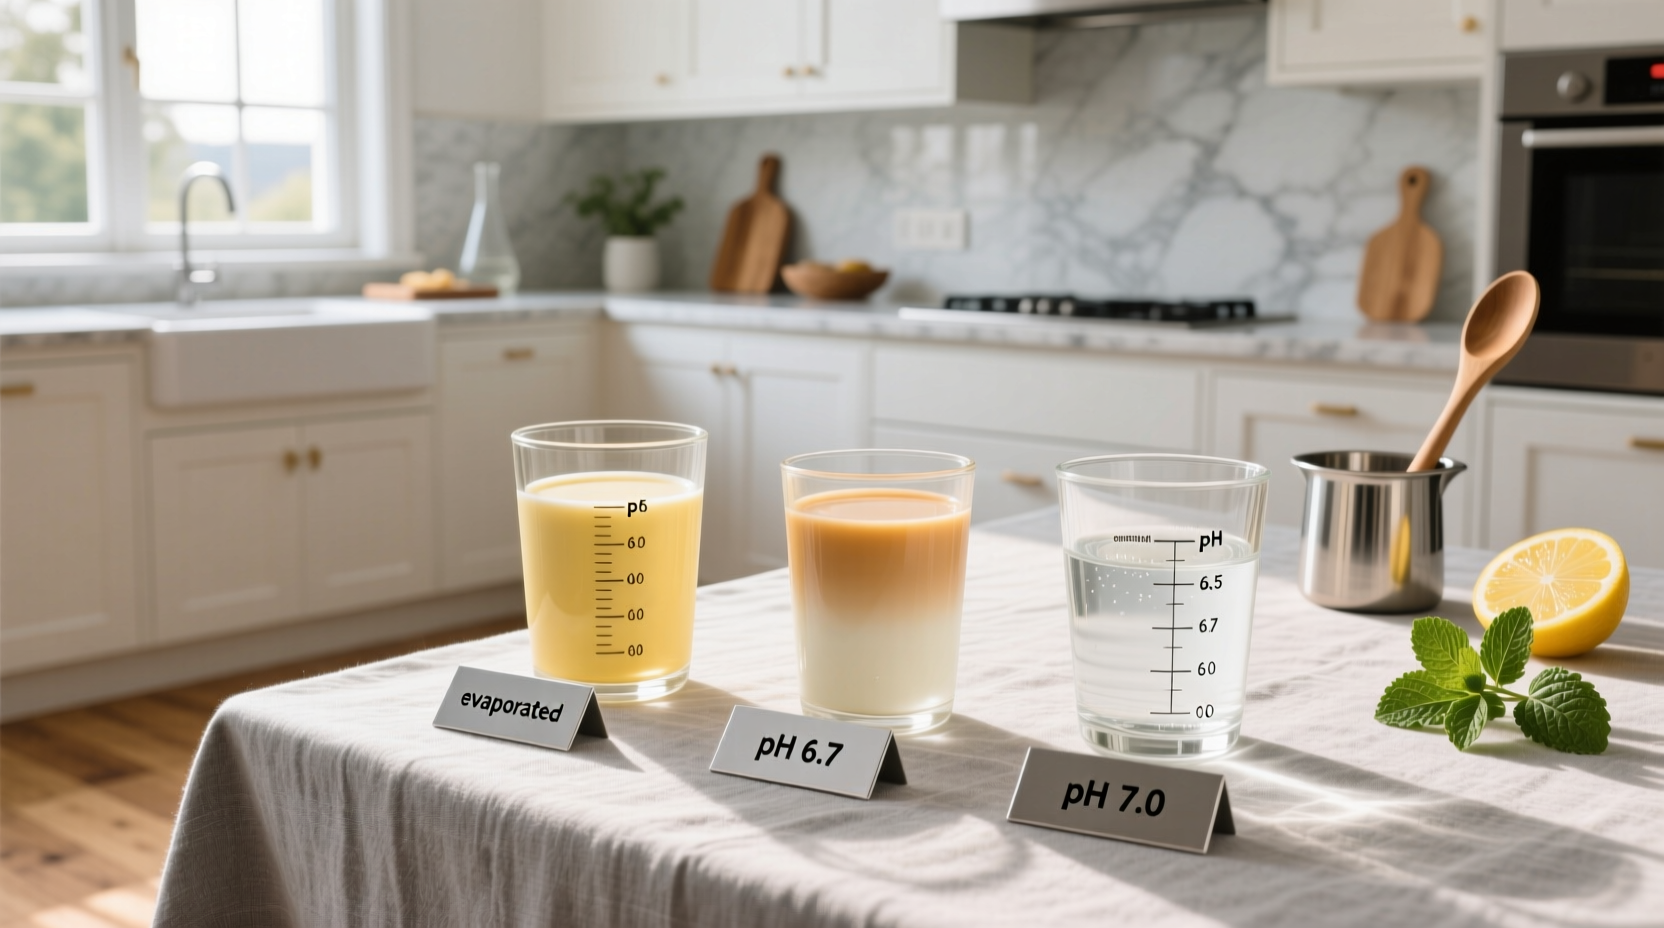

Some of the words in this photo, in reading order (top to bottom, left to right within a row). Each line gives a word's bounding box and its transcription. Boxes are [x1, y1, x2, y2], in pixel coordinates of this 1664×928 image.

[627, 535, 646, 550] 60
[1199, 529, 1223, 553] pH
[1199, 574, 1223, 591] 6.5
[1197, 661, 1216, 676] 60
[460, 692, 564, 723] evaporated
[1195, 704, 1214, 719] 00
[754, 733, 798, 761] pH
[801, 739, 844, 767] 6.7
[1061, 779, 1110, 810] pH
[1119, 784, 1166, 818] 7.0
